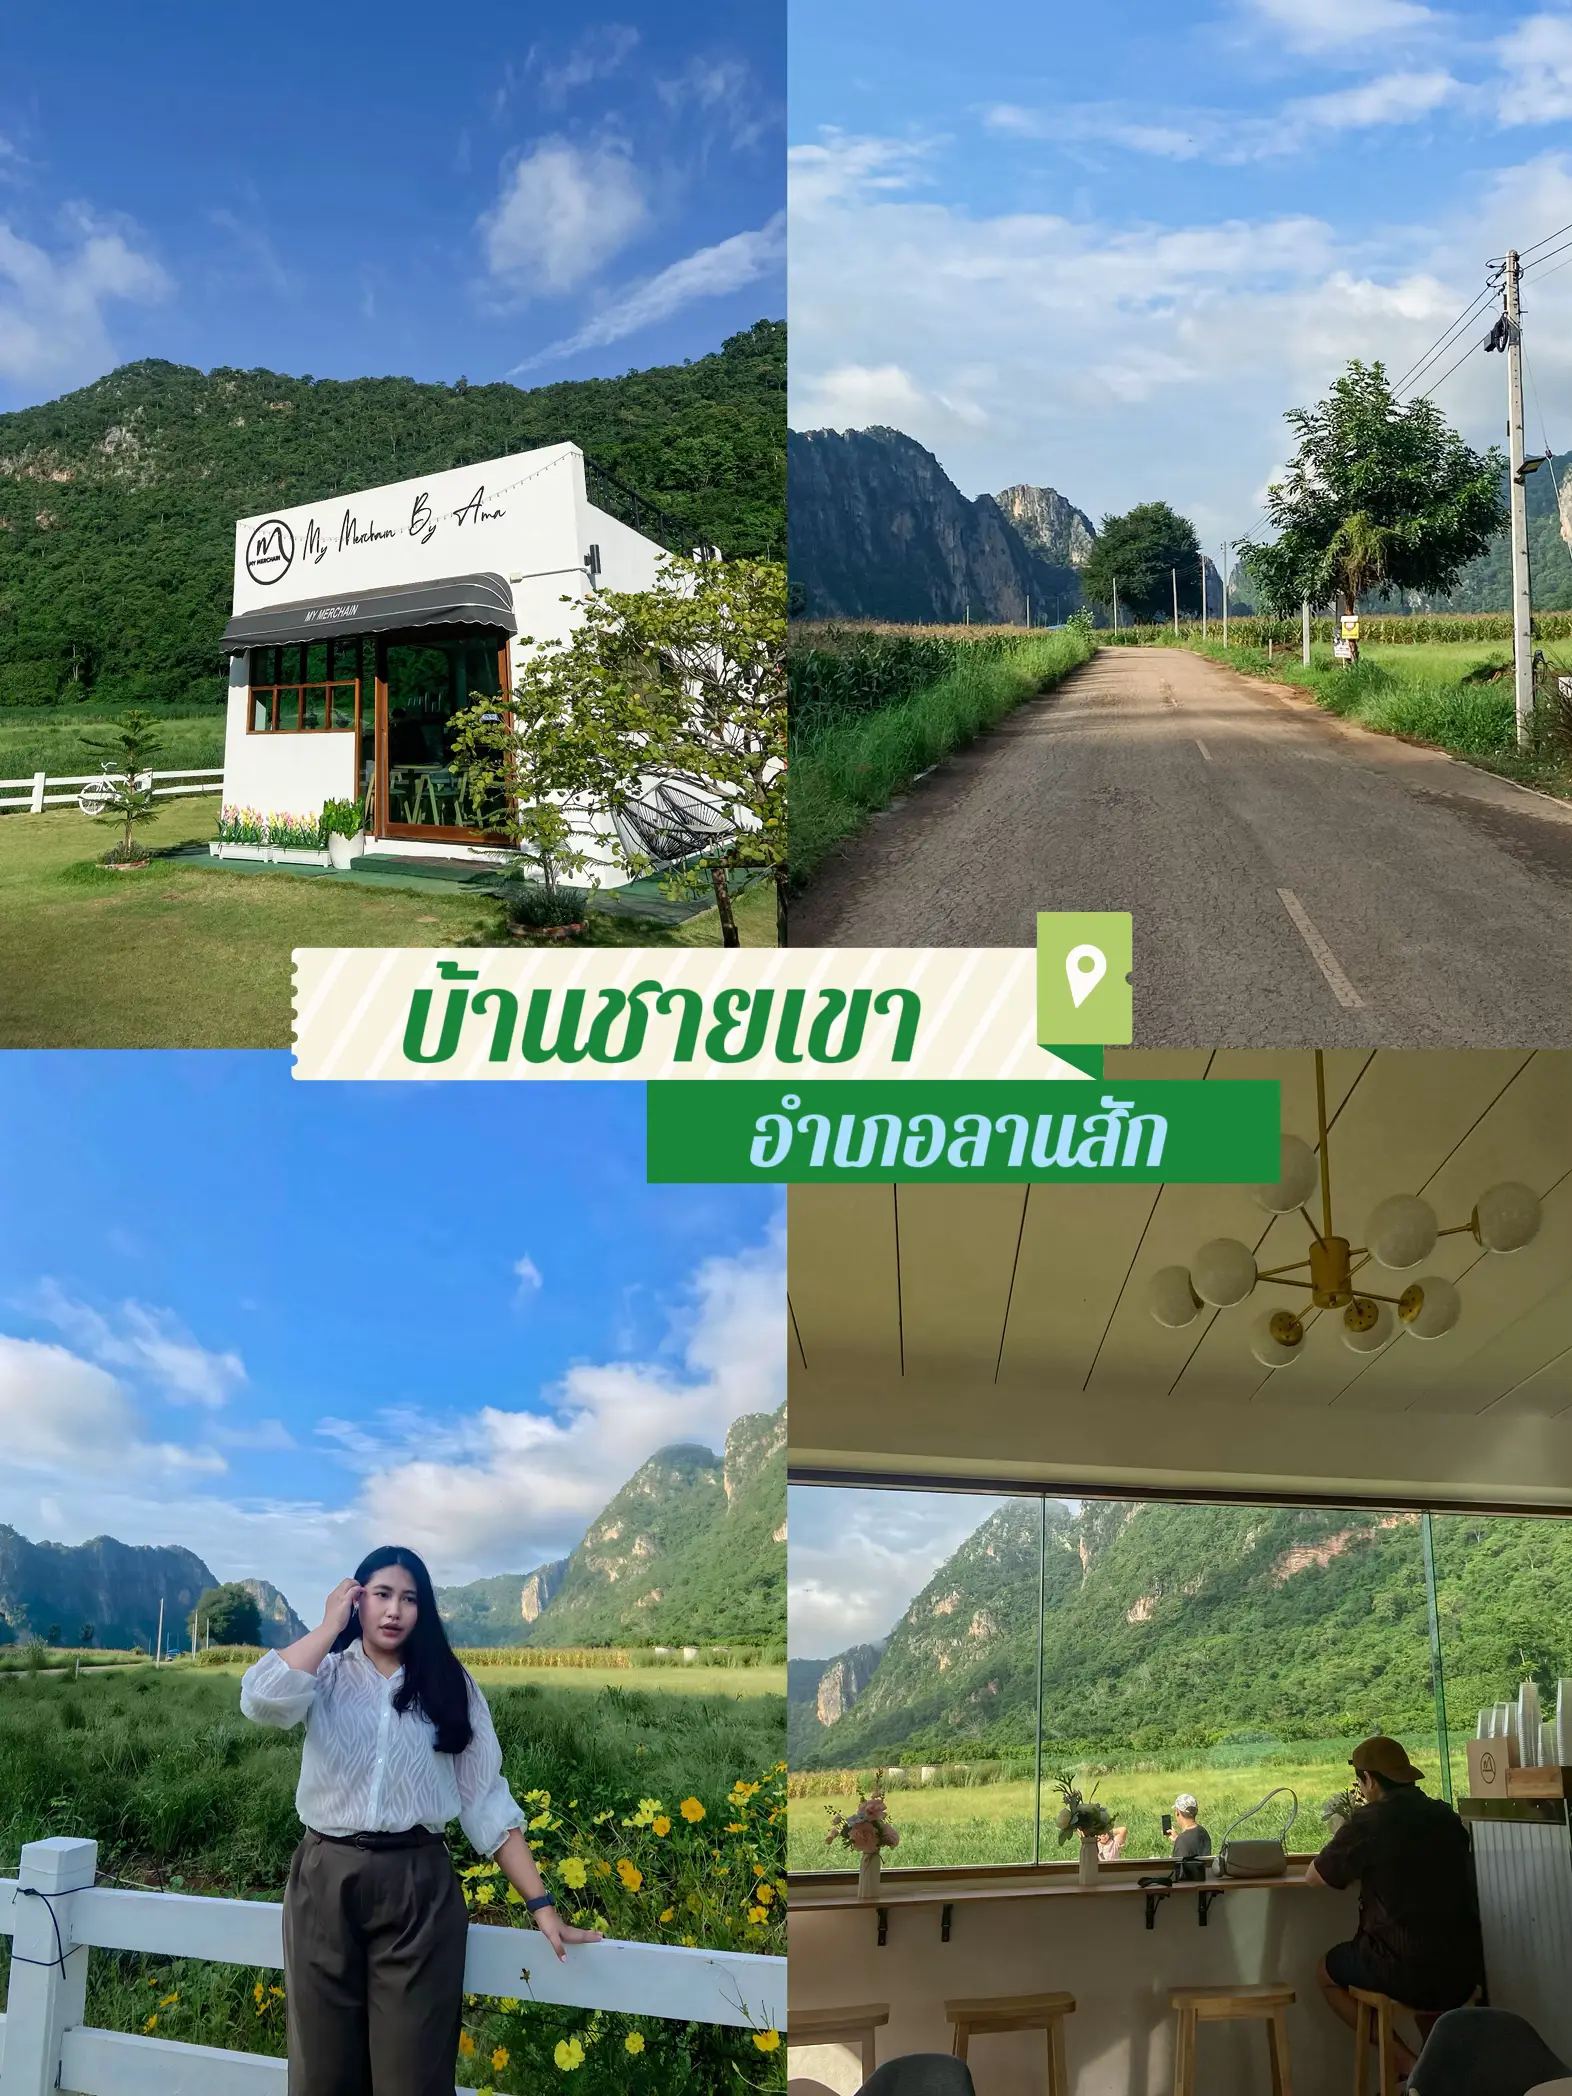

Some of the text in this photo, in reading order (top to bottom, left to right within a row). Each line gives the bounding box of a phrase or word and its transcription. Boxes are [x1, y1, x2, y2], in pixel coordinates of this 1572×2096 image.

[303, 518, 328, 565] My
[409, 492, 437, 544] By
[452, 485, 507, 527] Ama
[256, 555, 281, 566] MERCHAIN
[304, 604, 359, 622] MY MERCHAIN
